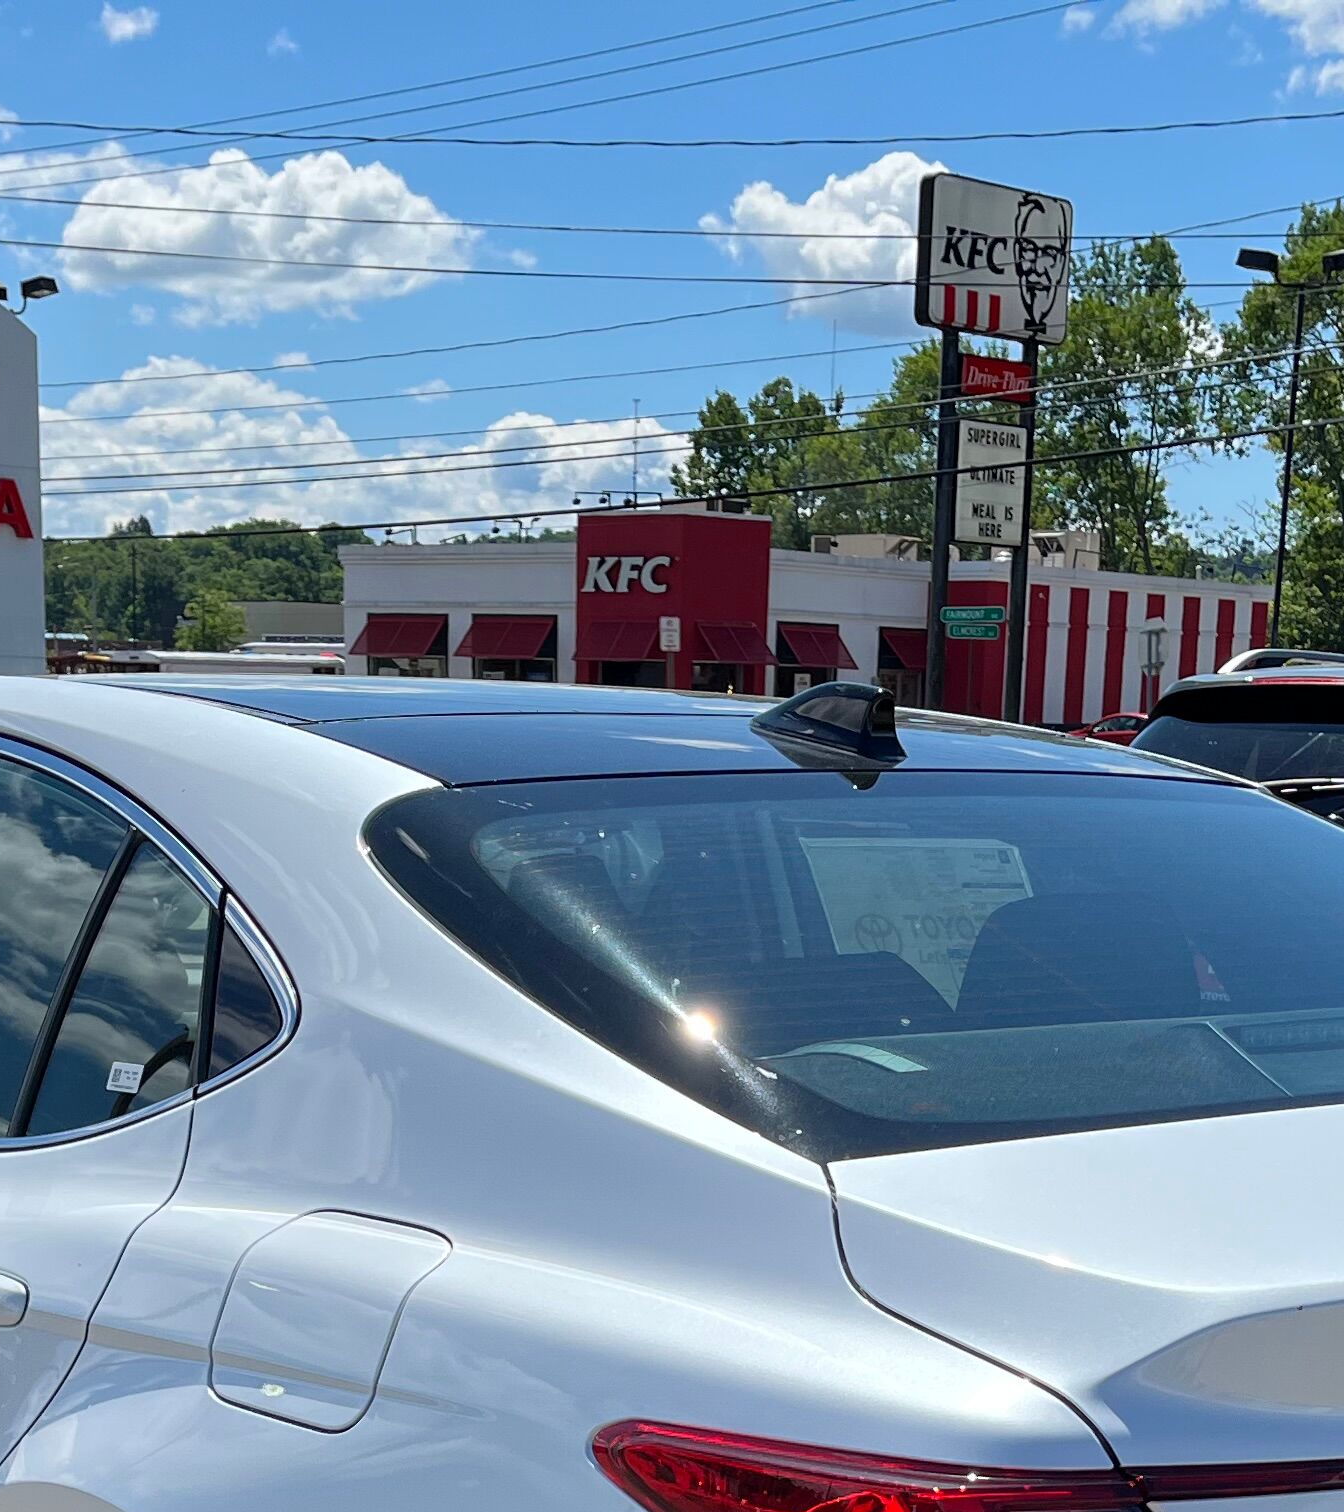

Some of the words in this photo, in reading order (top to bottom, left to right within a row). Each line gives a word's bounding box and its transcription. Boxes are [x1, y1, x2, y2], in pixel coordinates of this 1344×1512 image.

[940, 226, 1007, 275] KFC
[967, 427, 1021, 449] SUPERGIRL
[970, 465, 1016, 485] ULTIMATE
[971, 503, 996, 520] MEAL
[1004, 506, 1014, 521] IS
[978, 522, 1002, 539] HERE
[580, 556, 671, 593] KFC
